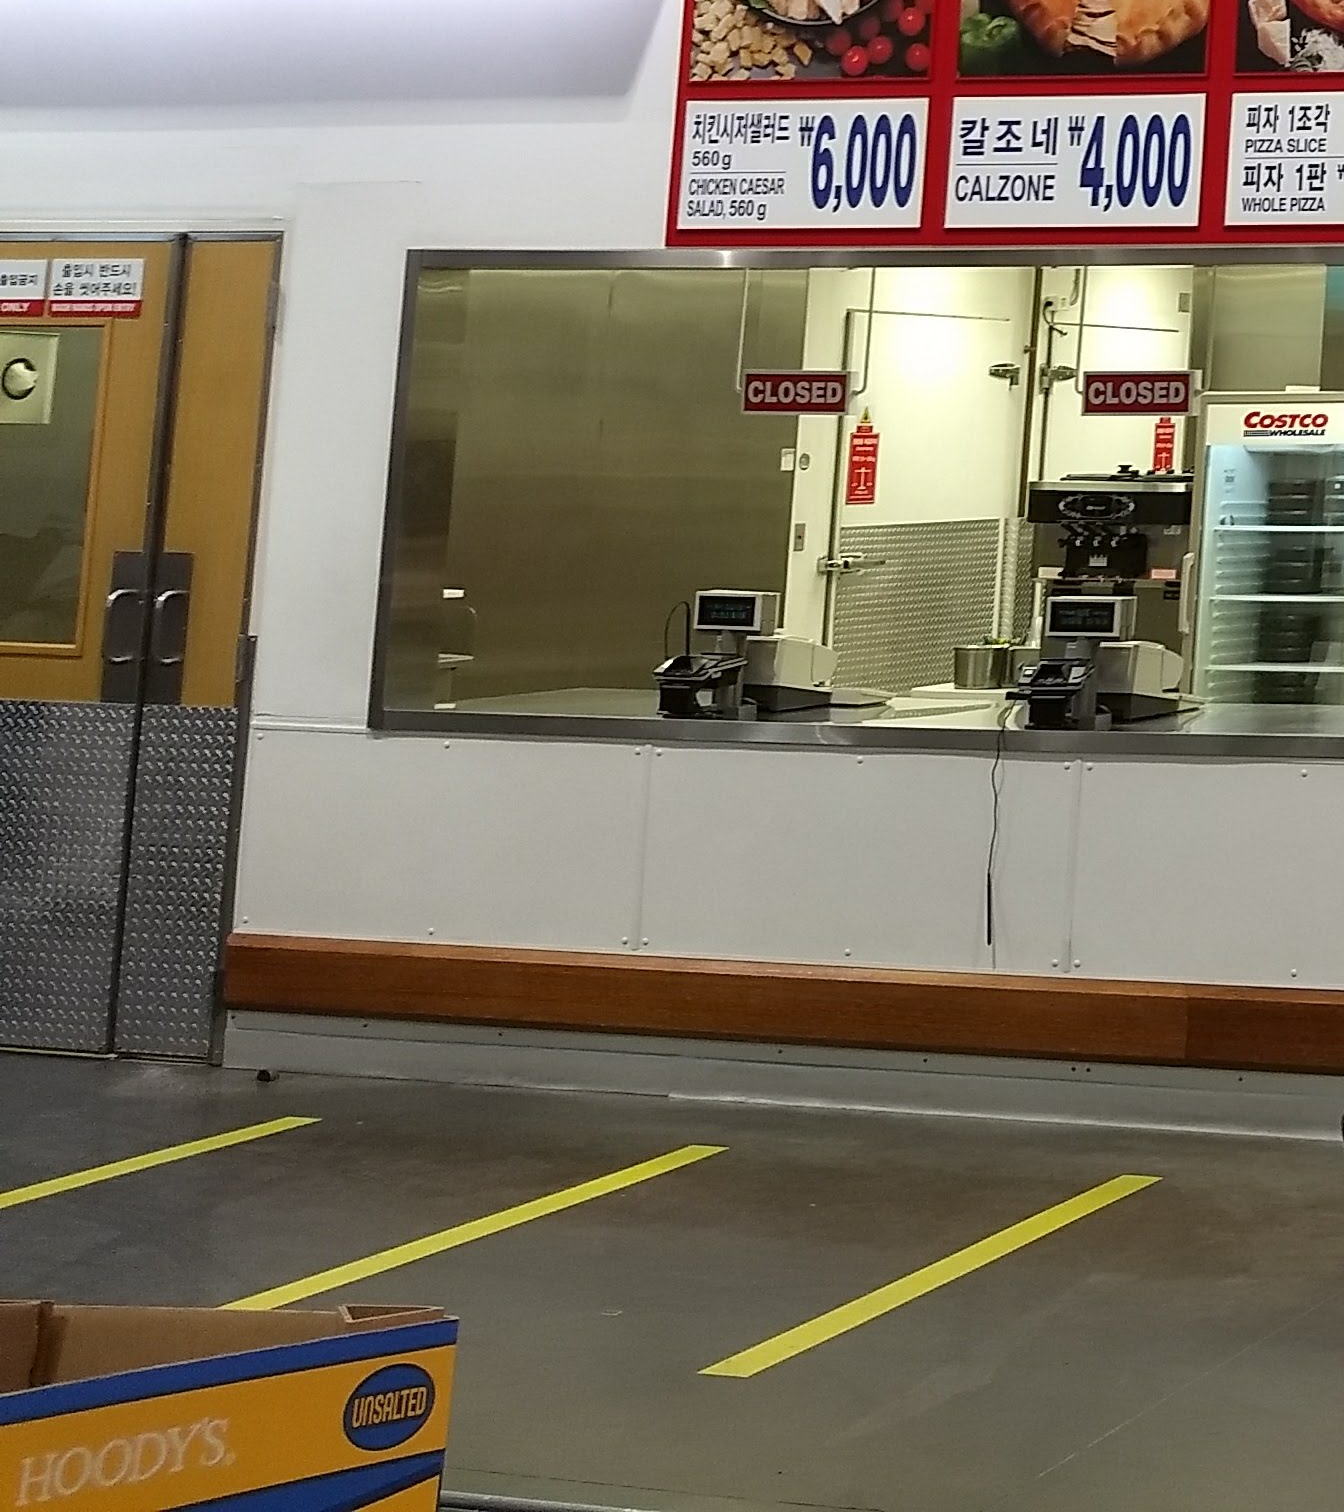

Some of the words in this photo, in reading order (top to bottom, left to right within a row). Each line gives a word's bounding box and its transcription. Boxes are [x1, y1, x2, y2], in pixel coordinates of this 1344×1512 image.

[691, 113, 790, 144] 치킨시저샐러드
[1246, 104, 1279, 134] 피자
[1288, 103, 1330, 133] 1조각
[1245, 139, 1283, 153] PIZZA
[1287, 138, 1327, 153] SLICE
[689, 178, 737, 195] CHICKEN
[740, 177, 785, 195] CAESAR
[955, 175, 1055, 202] CALZONE
[1242, 162, 1284, 193] 피자
[1295, 162, 1327, 192] 1판
[687, 200, 726, 219] SALAD,
[1241, 197, 1287, 212] WHOLE
[1290, 197, 1326, 212] PIZZA
[747, 377, 843, 406] CLOSED
[1088, 377, 1187, 405] CLOSED
[1244, 412, 1328, 429] COSTCO
[1270, 429, 1326, 437] WHOLESALE
[351, 1386, 427, 1429] UNSALTED
[15, 1417, 230, 1507] HOODY'S
